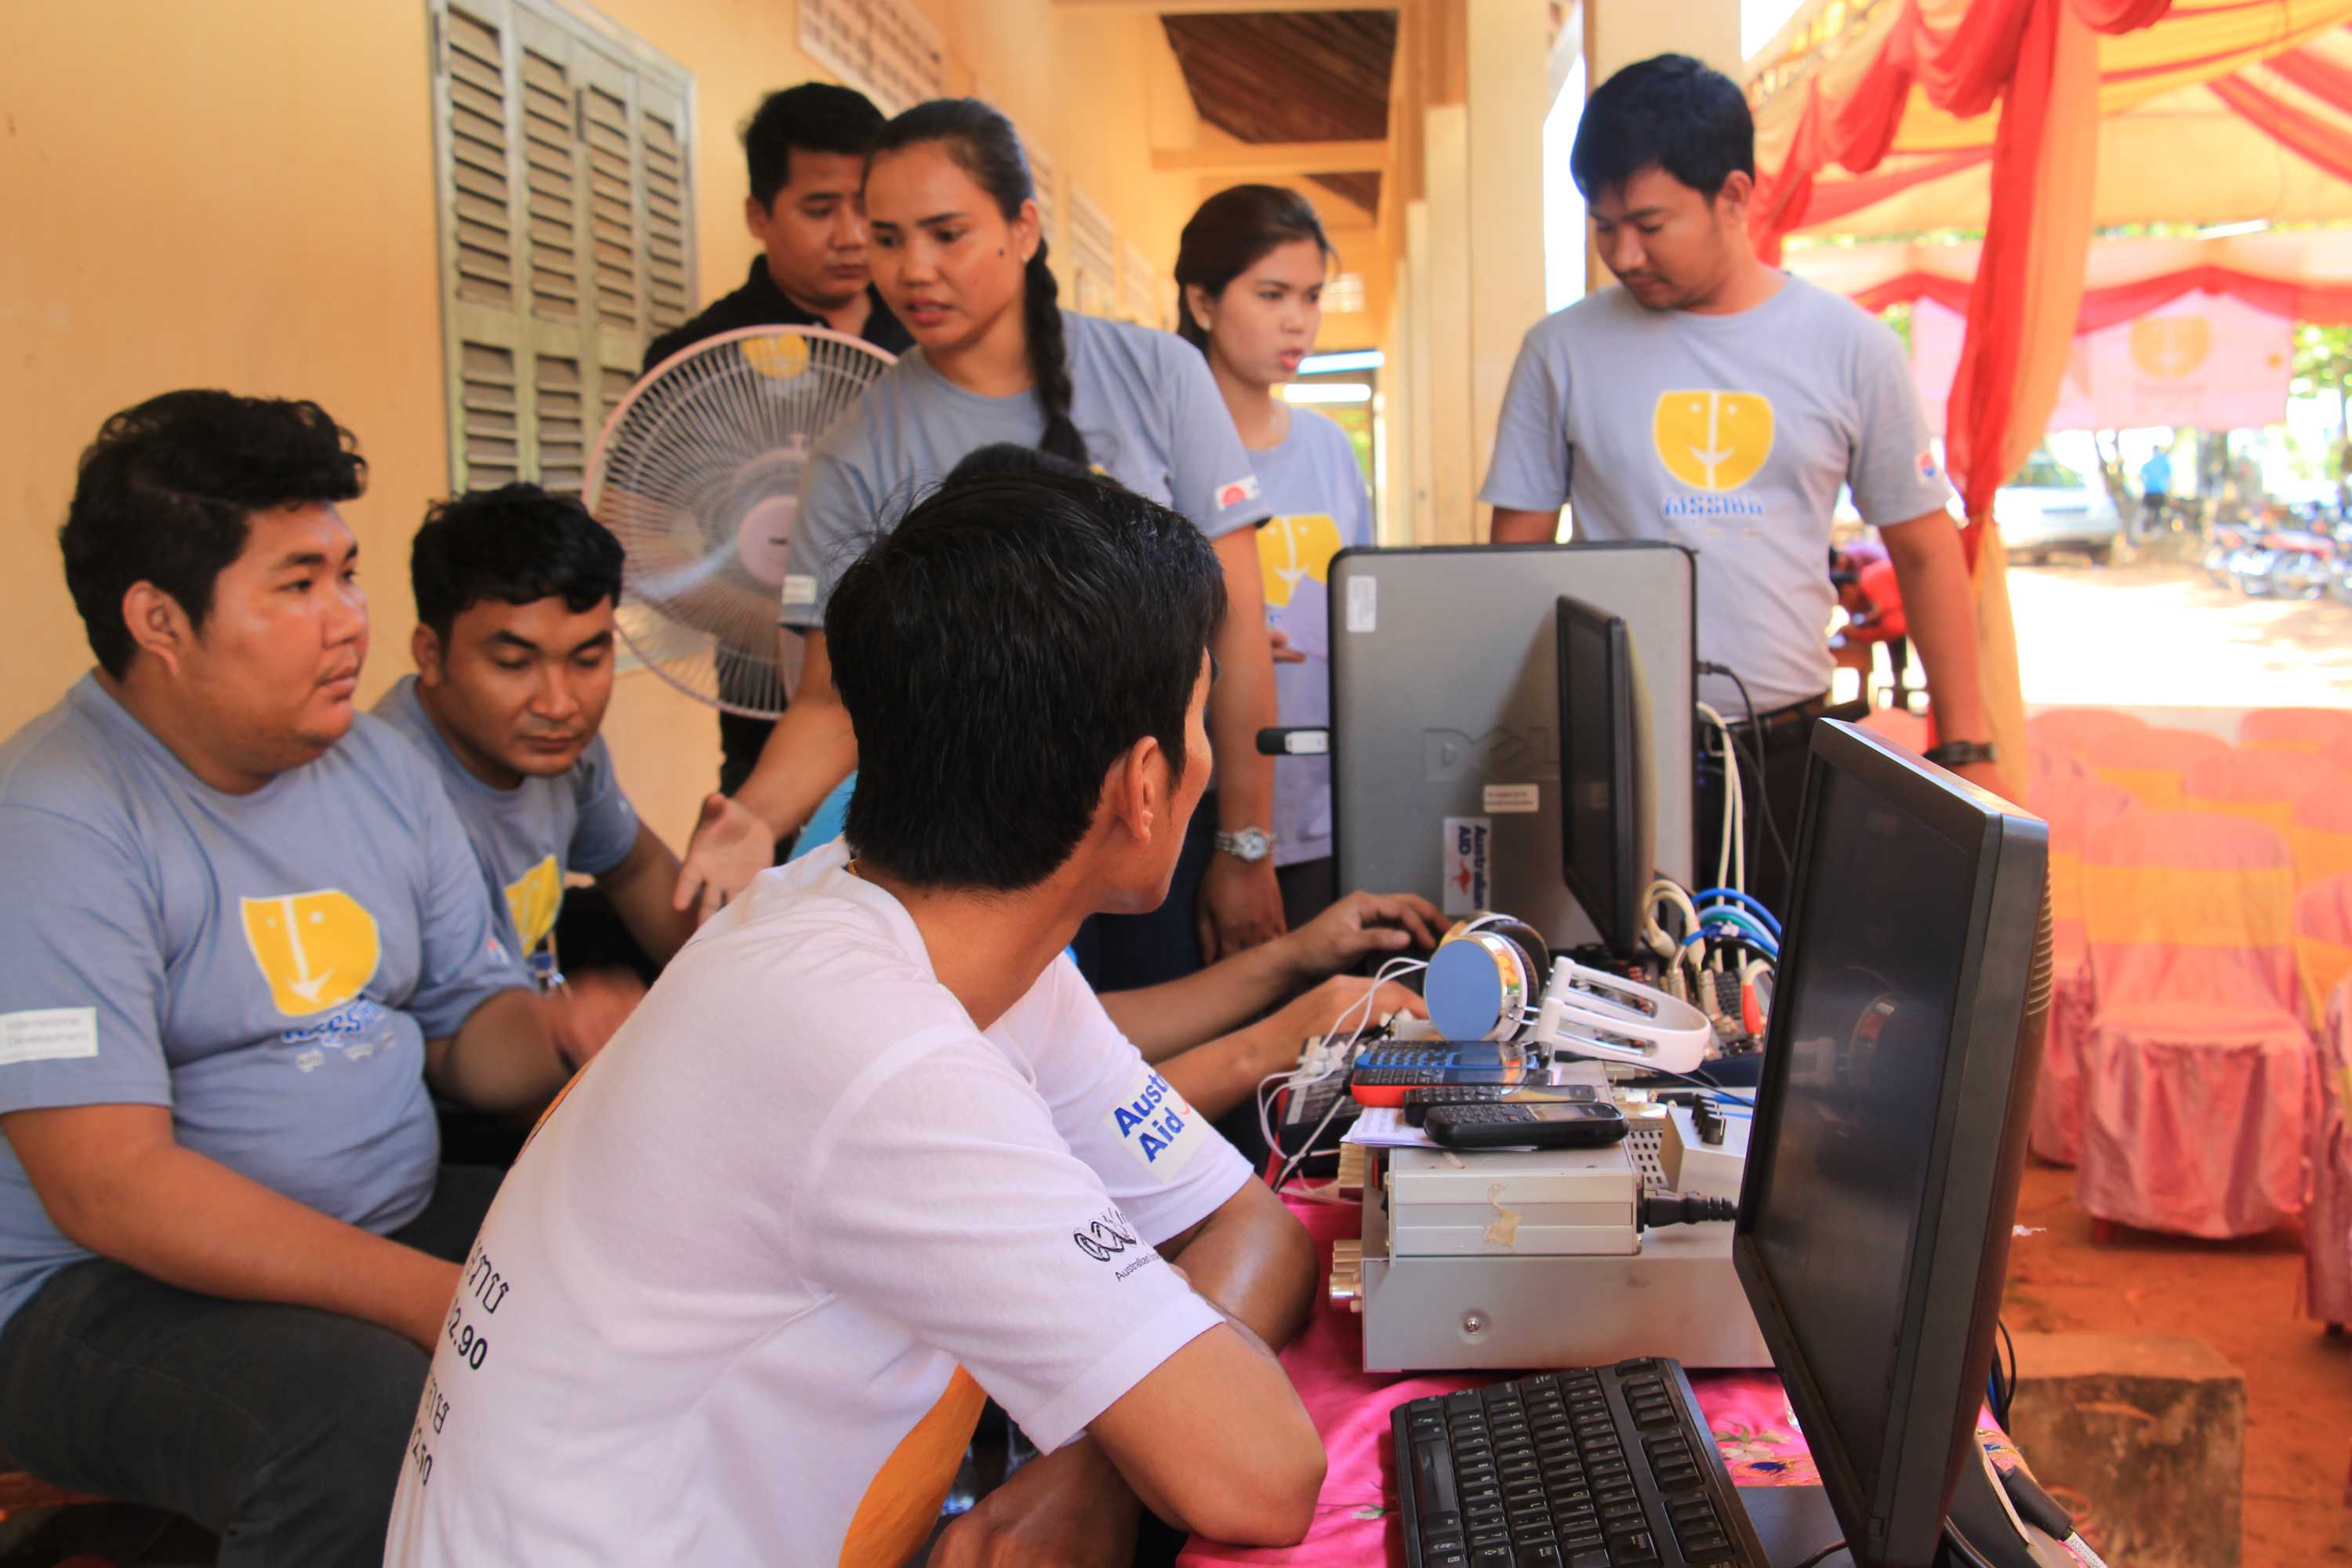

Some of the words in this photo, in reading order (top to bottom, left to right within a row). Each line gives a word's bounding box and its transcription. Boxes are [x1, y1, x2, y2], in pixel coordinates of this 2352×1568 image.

[1459, 826, 1471, 855] AID
[1474, 826, 1487, 909] Australian
[1139, 1106, 1185, 1163] Aid
